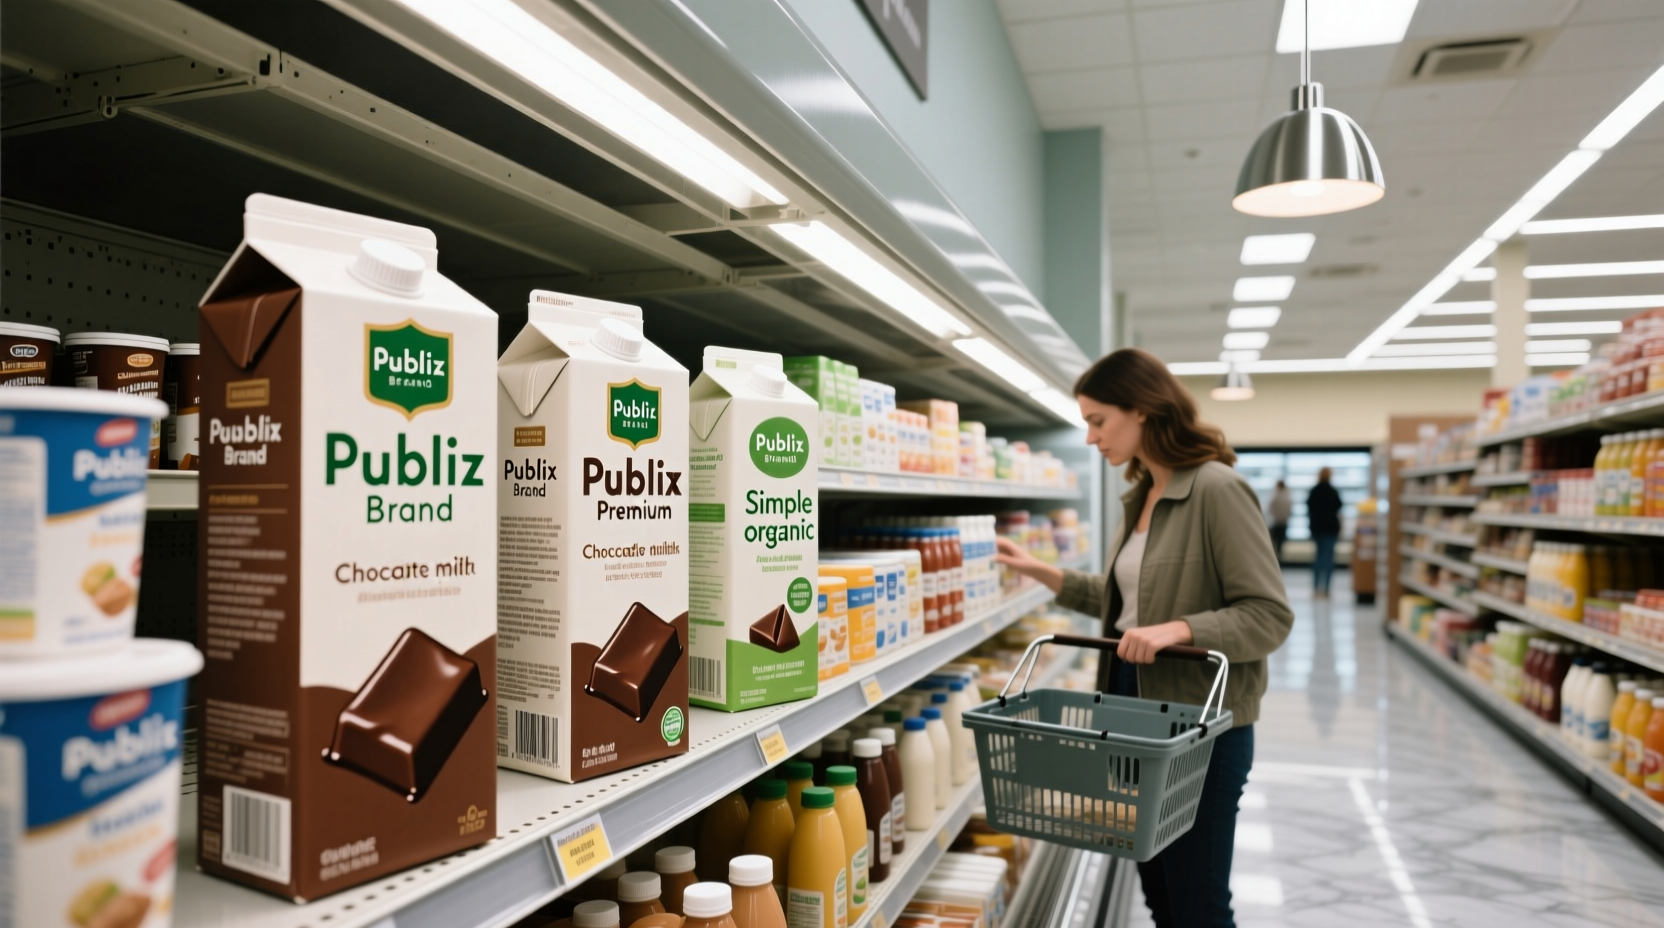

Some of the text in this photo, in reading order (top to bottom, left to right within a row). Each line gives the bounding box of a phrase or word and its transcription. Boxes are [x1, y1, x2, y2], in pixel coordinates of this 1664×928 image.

[374, 346, 446, 377] Publiz
[224, 443, 267, 465] Brand
[326, 432, 485, 487] Publiz
[504, 458, 557, 481] Publix
[514, 482, 546, 498] Brand
[583, 457, 682, 496] Publix
[367, 493, 453, 524] Brand
[597, 499, 672, 521] Premium
[745, 489, 813, 520] Simple
[744, 518, 815, 549] organic
